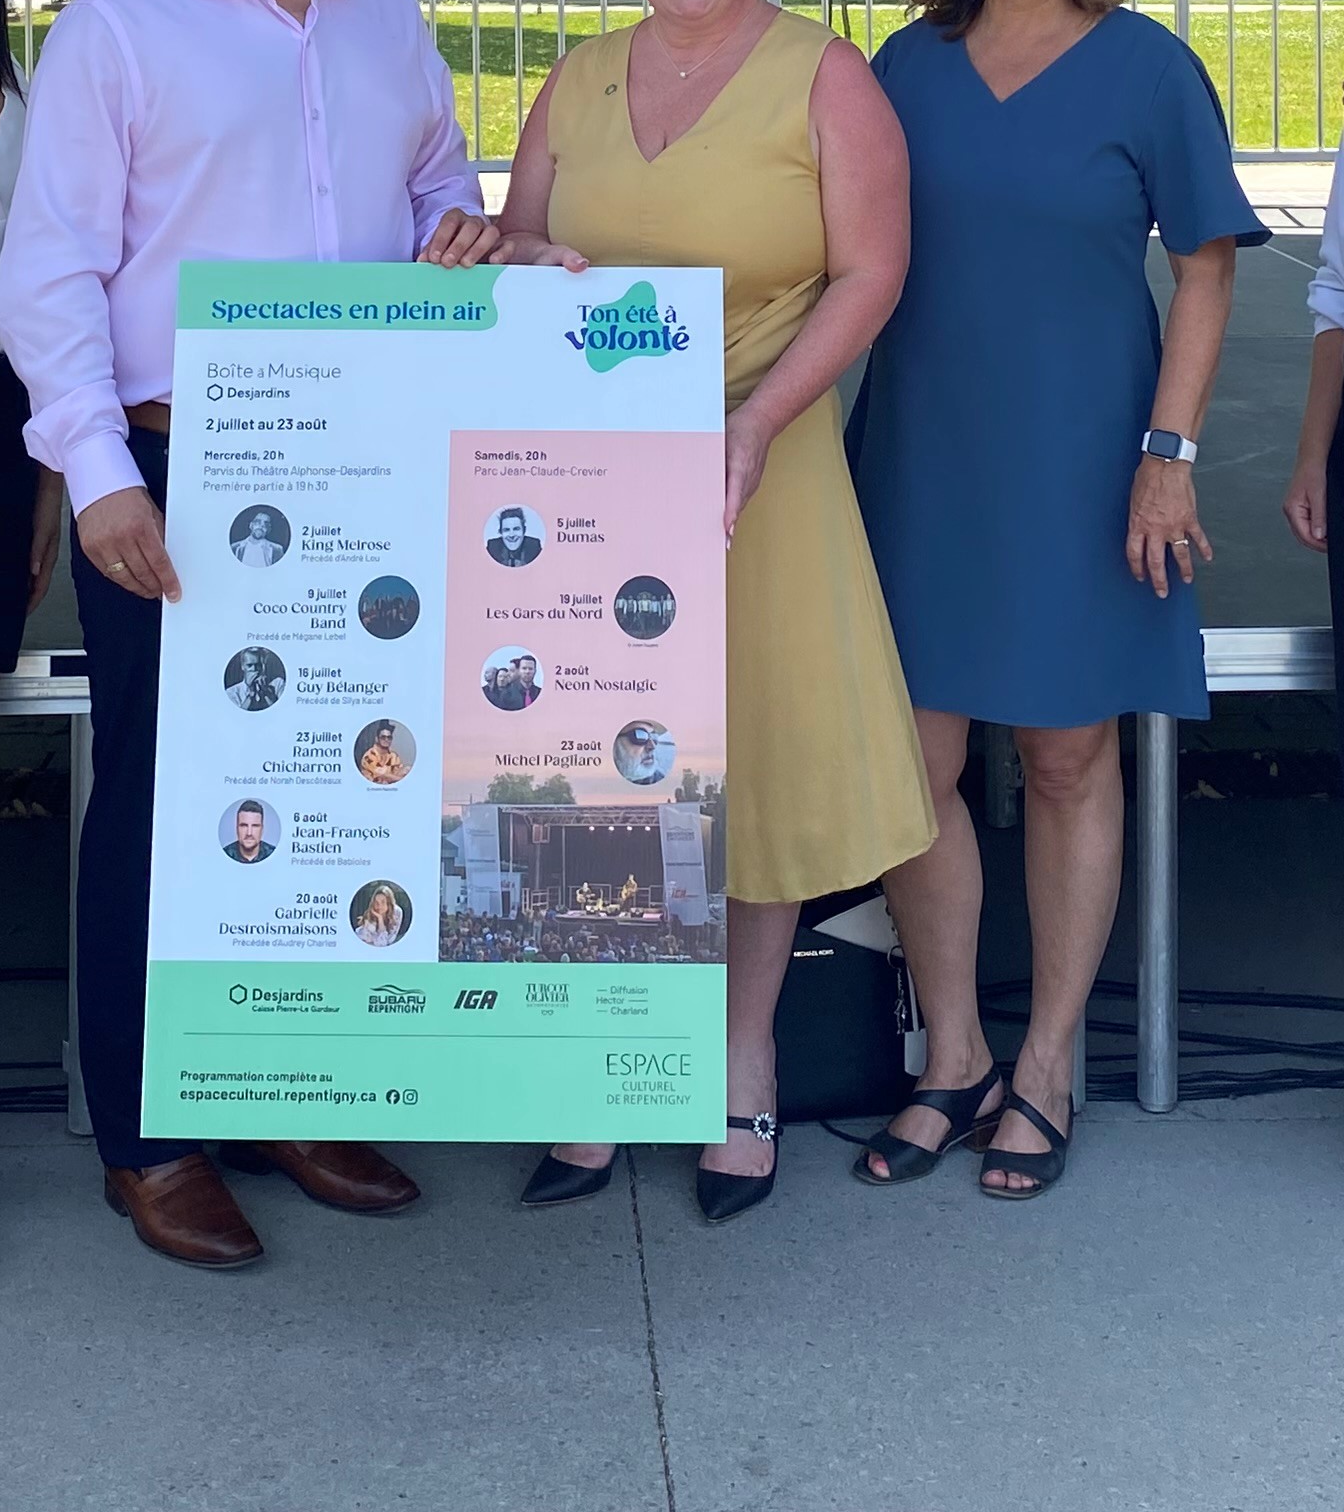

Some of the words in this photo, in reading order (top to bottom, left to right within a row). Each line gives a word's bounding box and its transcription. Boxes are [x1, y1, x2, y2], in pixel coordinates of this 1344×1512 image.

[212, 300, 343, 323] Spectacles
[349, 304, 379, 320] en
[386, 301, 446, 324] plein
[452, 301, 486, 321] air
[578, 304, 620, 323] Ton
[626, 304, 659, 323] été
[664, 306, 677, 323] à
[564, 325, 690, 351] volonté
[206, 362, 254, 379] Boîte
[268, 363, 342, 382] Musique
[227, 388, 290, 401] Desjardins
[206, 418, 214, 431] 2
[216, 418, 255, 433] juillet
[258, 421, 275, 431] au
[277, 418, 294, 431] 23
[296, 418, 327, 431] août
[204, 450, 261, 462] Mercredis,
[474, 450, 523, 462] Samedis,
[204, 466, 234, 476] Parvis
[236, 466, 249, 476] du
[251, 466, 289, 476] Théâtre
[290, 466, 392, 478] Alphonse-Desjardins
[474, 466, 498, 477] Parc
[500, 466, 608, 477] Jean-Claude-Crevier
[203, 481, 251, 492] Première
[254, 482, 285, 493] partie
[287, 482, 294, 492] à
[557, 518, 564, 527] 5
[566, 518, 596, 530] juillet
[302, 526, 309, 536] 2
[311, 526, 342, 538] juillet
[557, 532, 605, 543] Dumas
[302, 539, 334, 553] King
[337, 540, 391, 551] Melrose
[308, 590, 315, 599] 9
[316, 590, 347, 601] juillet
[560, 594, 570, 604] 19
[572, 594, 603, 606] juillet
[253, 602, 288, 614] Coco
[292, 602, 347, 617] Country
[486, 608, 509, 619] Les
[513, 608, 545, 619] Gars
[548, 608, 565, 619] du
[569, 608, 603, 619] Nord
[310, 618, 346, 629] Band
[298, 668, 309, 678] 16
[310, 668, 342, 680] juillet
[556, 666, 562, 675] 2
[564, 666, 589, 675] août
[296, 681, 323, 695] Guy
[326, 680, 389, 695] Bélanger
[556, 680, 590, 691] Neon
[594, 680, 658, 694] Nostalgic
[296, 732, 310, 742] 23
[311, 732, 343, 744] juillet
[293, 746, 342, 758] Ramon
[561, 741, 574, 751] 23
[576, 741, 602, 751] août
[262, 760, 342, 773] Chicharron
[495, 754, 540, 766] Michel
[544, 754, 602, 768] Pagliaro
[294, 812, 300, 822] 6
[302, 812, 328, 822] août
[292, 826, 390, 841] Jean-François
[292, 842, 342, 854] Bastien
[296, 894, 310, 904] 20
[312, 894, 338, 904] août
[275, 908, 338, 920] Gabrielle
[219, 922, 337, 935] Destroismaisons
[252, 988, 324, 1004] Desjardins
[610, 986, 649, 995] Diffusion
[368, 995, 426, 1005] SUBARU
[454, 990, 498, 1010] IGA
[596, 996, 625, 1005] Hector
[368, 1004, 425, 1014] REPENTIGNY
[610, 1006, 649, 1016] Charland
[606, 1054, 692, 1076] ESPACE
[180, 1070, 264, 1083] Programmation
[266, 1072, 317, 1084] complète
[320, 1074, 333, 1083] au
[622, 1081, 676, 1092] CULTUREL
[180, 1089, 377, 1105] espaceculturel.repentigny.ca
[606, 1094, 621, 1105] DE
[624, 1094, 691, 1105] REPENTIGNY
